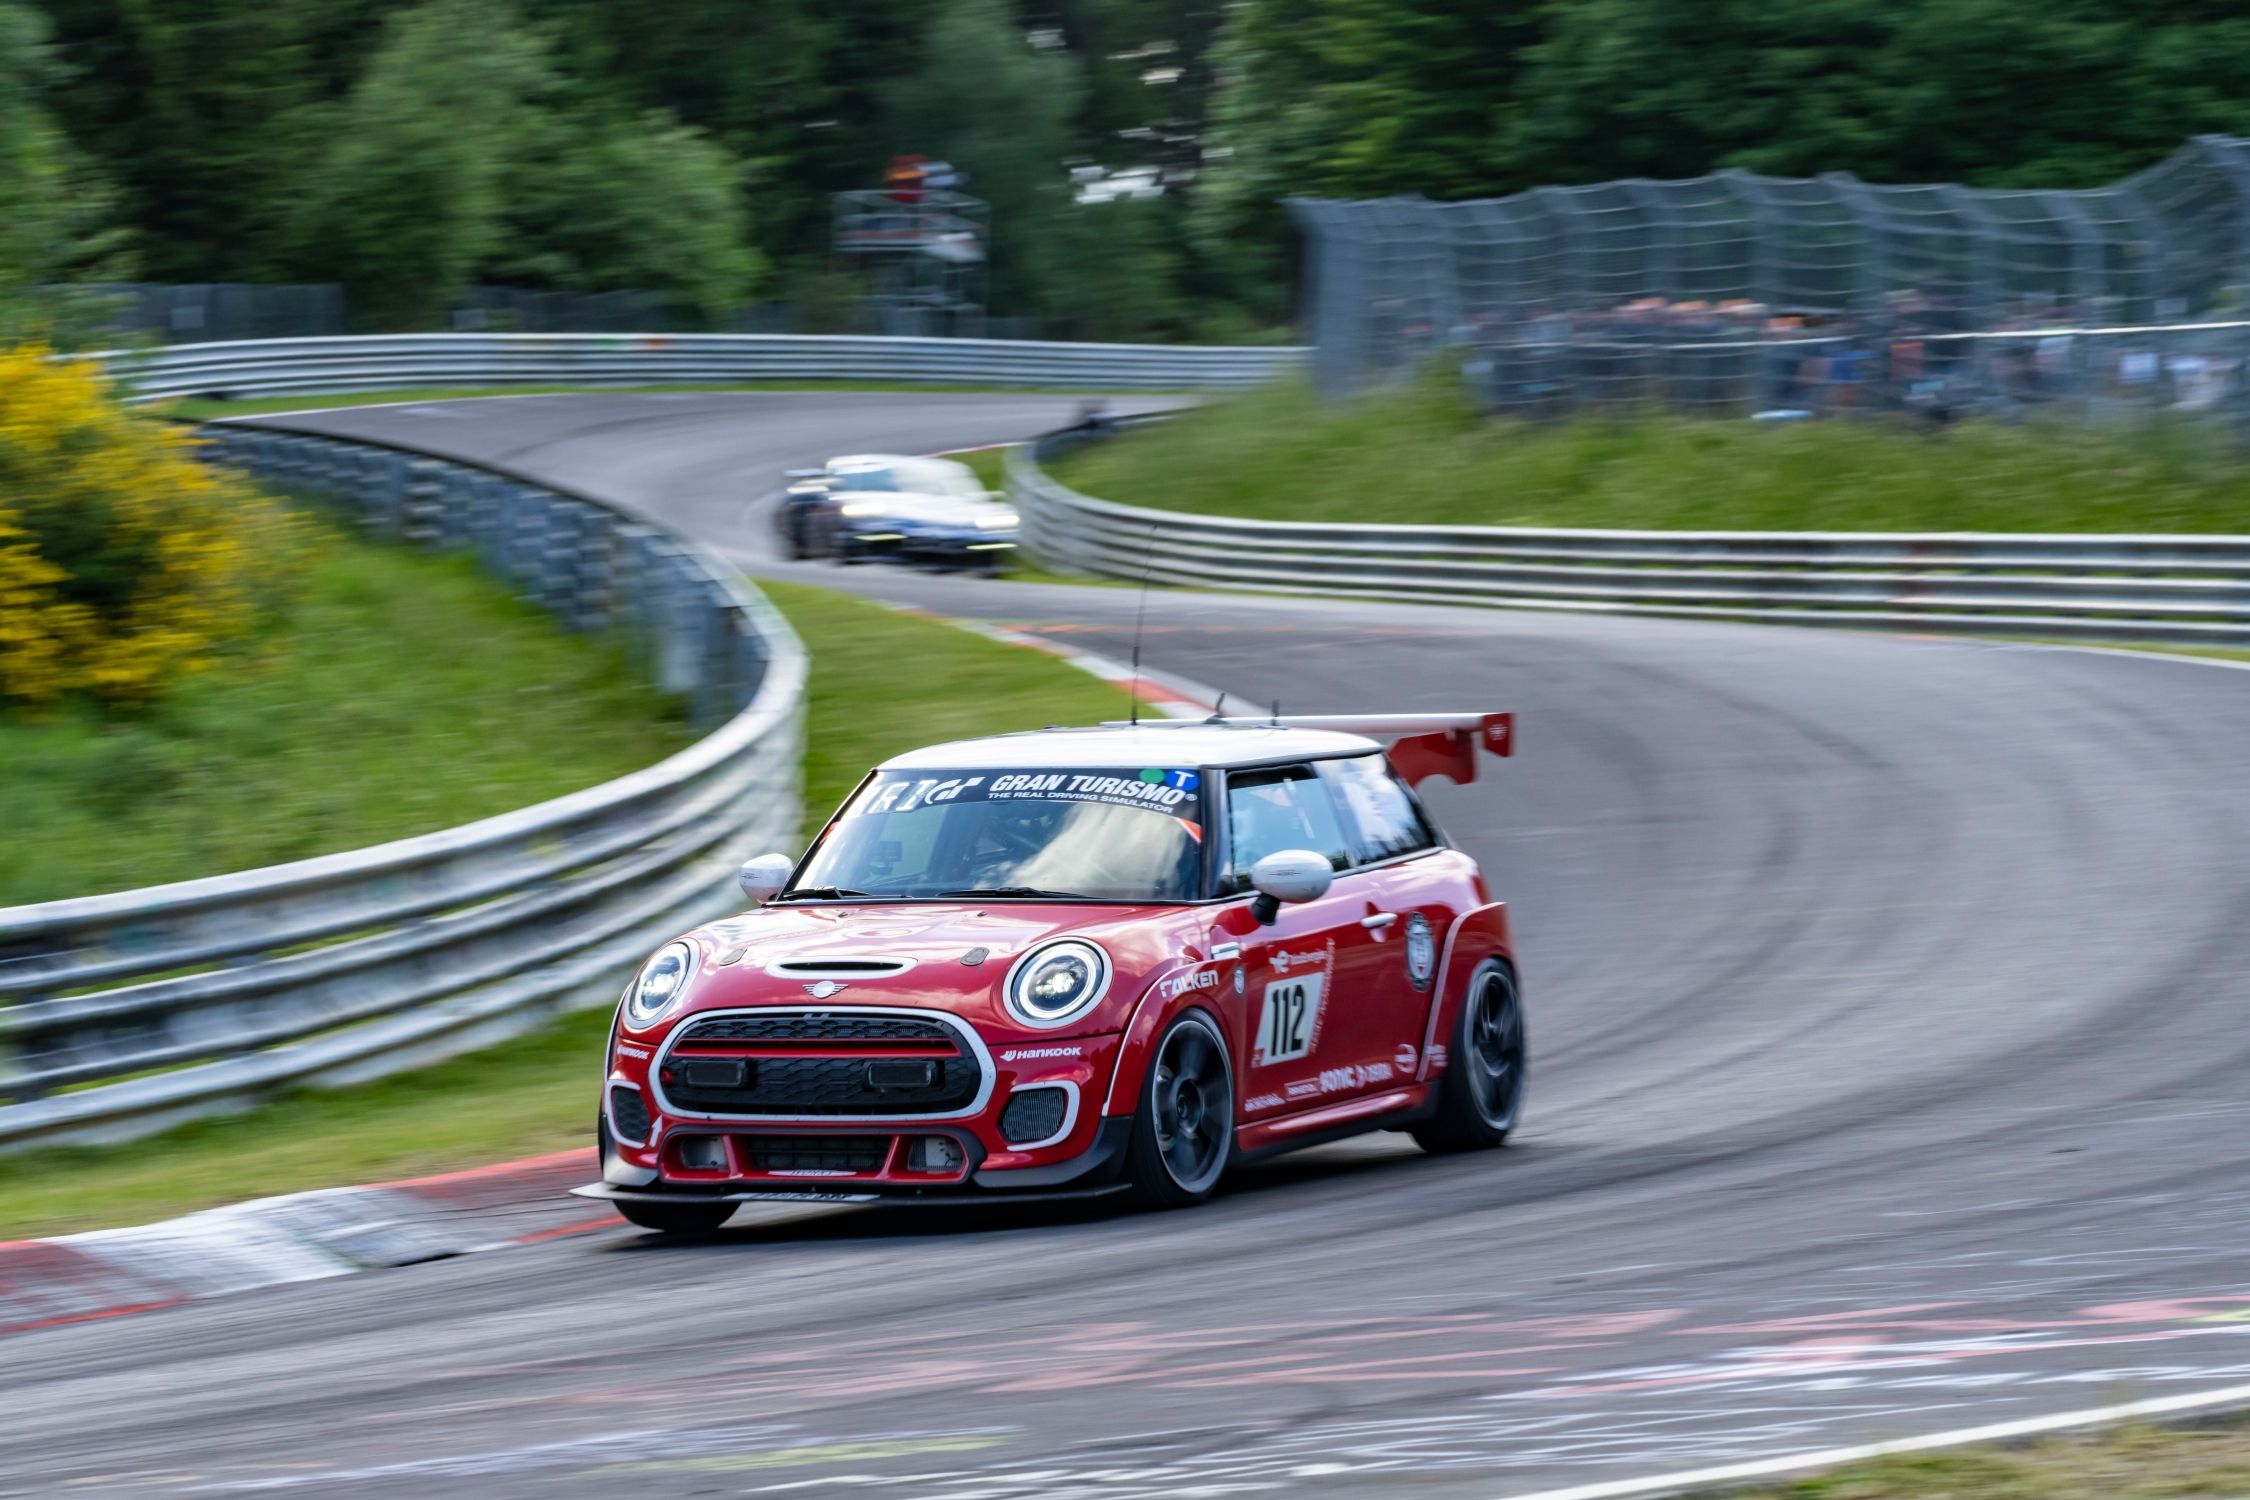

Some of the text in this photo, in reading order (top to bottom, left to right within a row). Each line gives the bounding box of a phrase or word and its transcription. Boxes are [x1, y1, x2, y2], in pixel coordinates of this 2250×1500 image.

[989, 774, 1068, 791] GRAN
[1174, 770, 1195, 787] T
[988, 791, 1011, 799] THE
[1046, 792, 1099, 801] DRIVING
[1100, 795, 1174, 814] SIMULATOR
[1159, 969, 1220, 998] FALKEN
[1271, 984, 1305, 1057] 112
